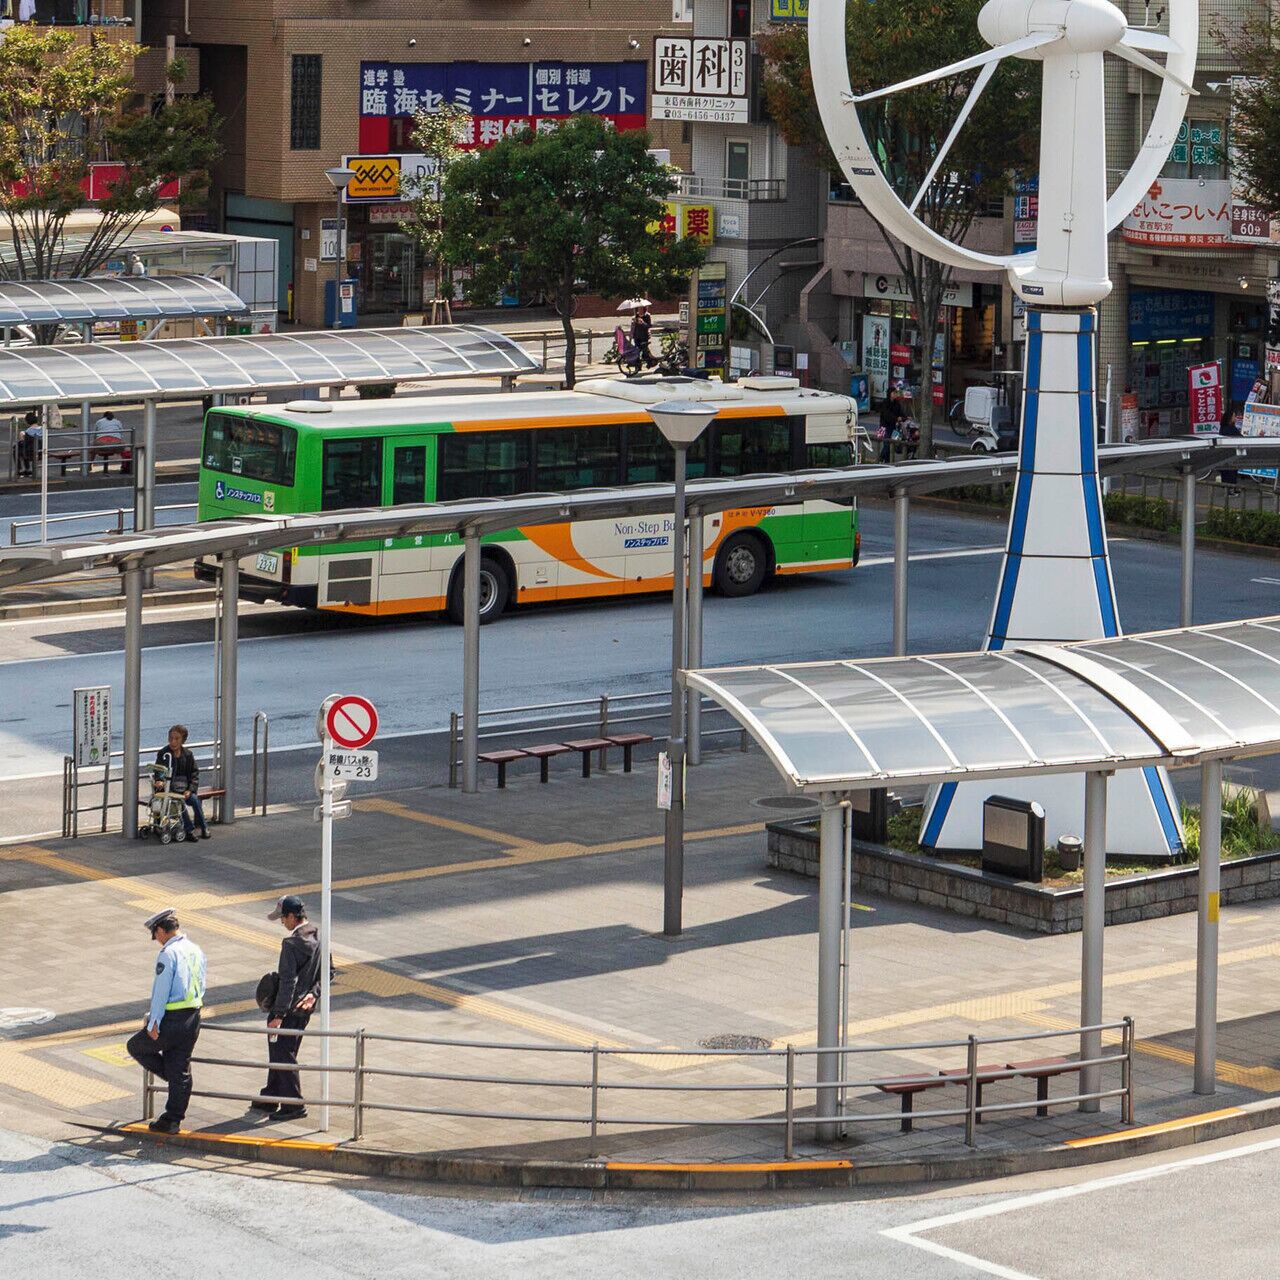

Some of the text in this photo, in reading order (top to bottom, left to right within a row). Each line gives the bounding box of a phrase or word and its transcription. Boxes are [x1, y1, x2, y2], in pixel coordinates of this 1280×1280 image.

[658, 44, 730, 88] 歯科
[733, 48, 744, 88] 3F
[364, 69, 591, 86] 進学塾 個別指導
[362, 86, 636, 115] 臨海セミナー セレクト
[665, 97, 736, 110] 東葛西歯科クリニック
[354, 165, 395, 184] GEO
[687, 208, 709, 236] 薬
[1240, 223, 1261, 235] 60分
[1197, 389, 1206, 422] ことなら
[227, 489, 261, 503] ノンステップバス
[663, 519, 676, 531] Bu
[625, 537, 669, 547] ノンステップバス
[330, 753, 372, 767] 路線バスを除く
